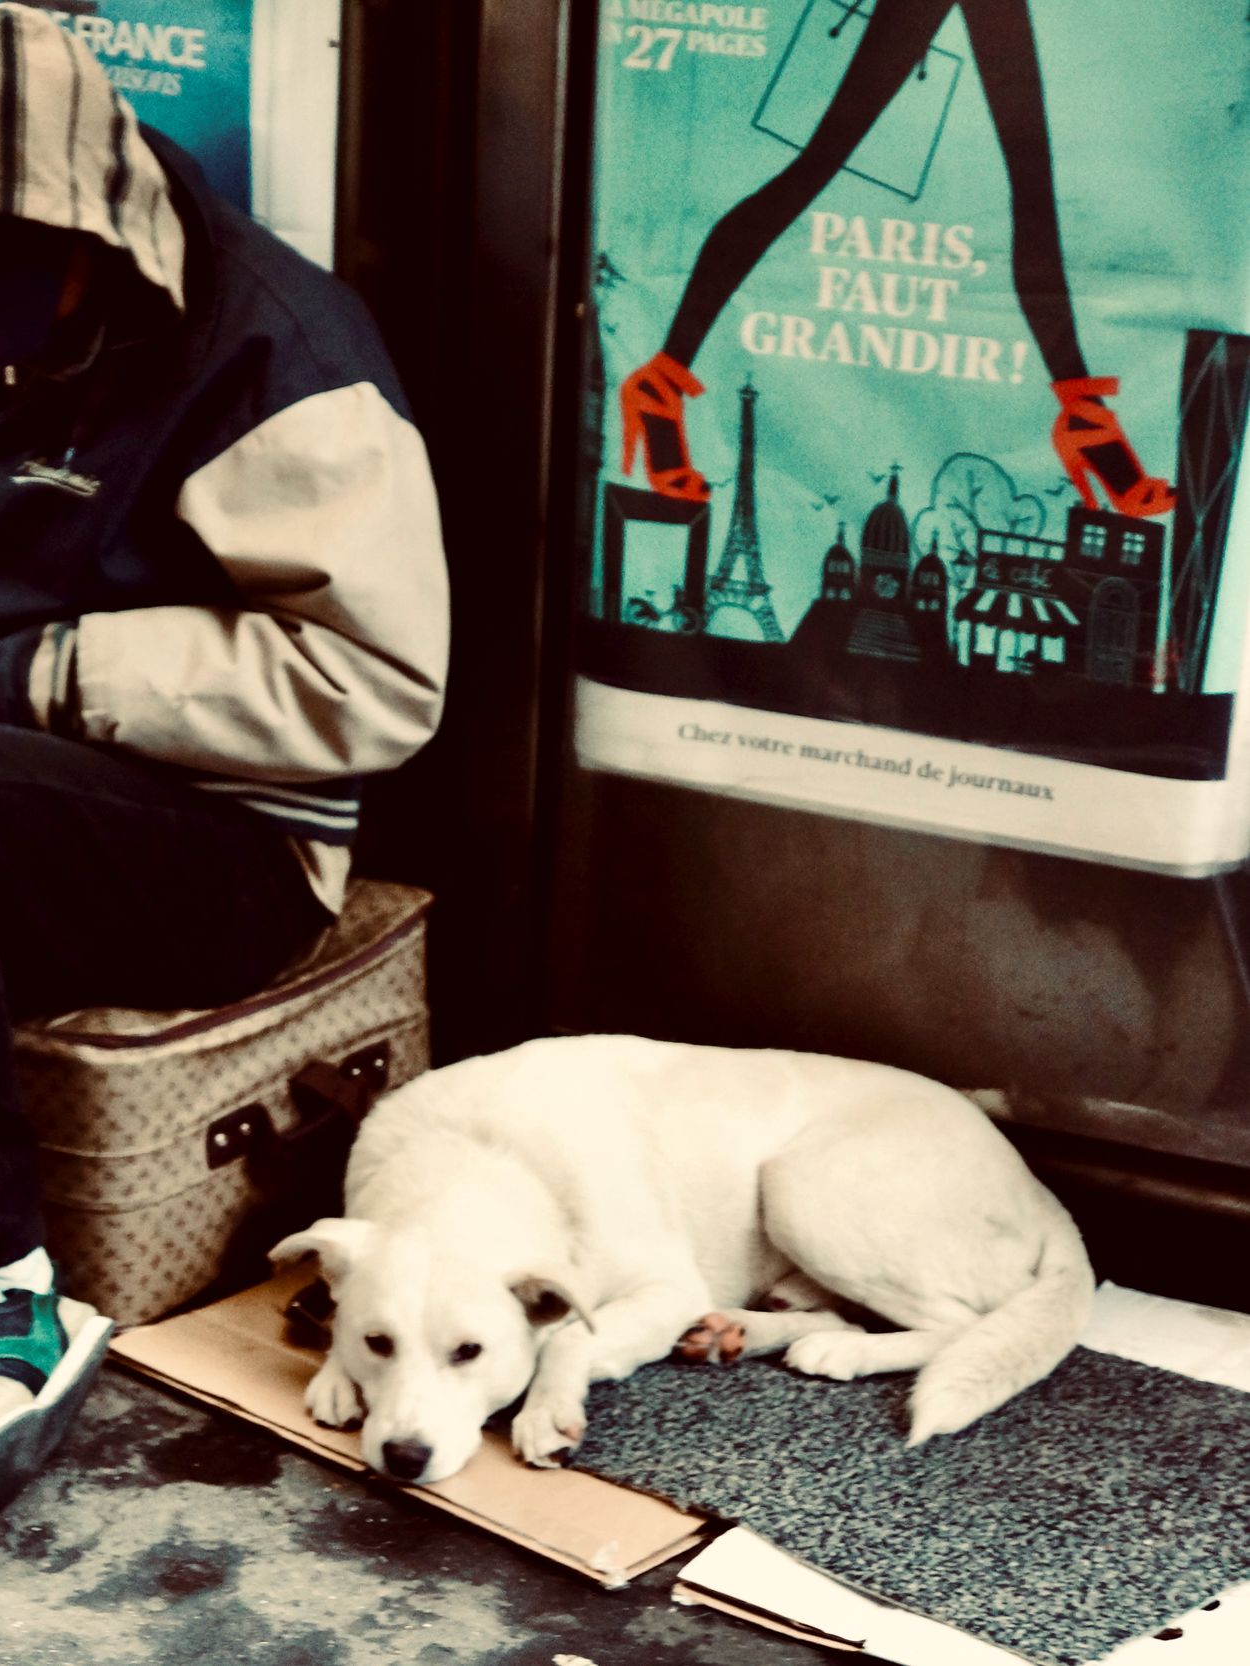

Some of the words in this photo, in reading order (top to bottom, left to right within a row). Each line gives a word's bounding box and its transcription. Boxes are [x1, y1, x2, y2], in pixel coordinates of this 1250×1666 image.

[74, 15, 206, 69] FRANCE
[622, 25, 684, 72] 27
[685, 30, 767, 57] PAGES
[808, 211, 989, 277] PARIS,
[816, 266, 959, 323] FAUT
[678, 723, 733, 745] Chez
[737, 734, 794, 755] votre
[800, 743, 913, 776] marchand
[916, 761, 944, 782] de
[947, 765, 1054, 802] journaux
